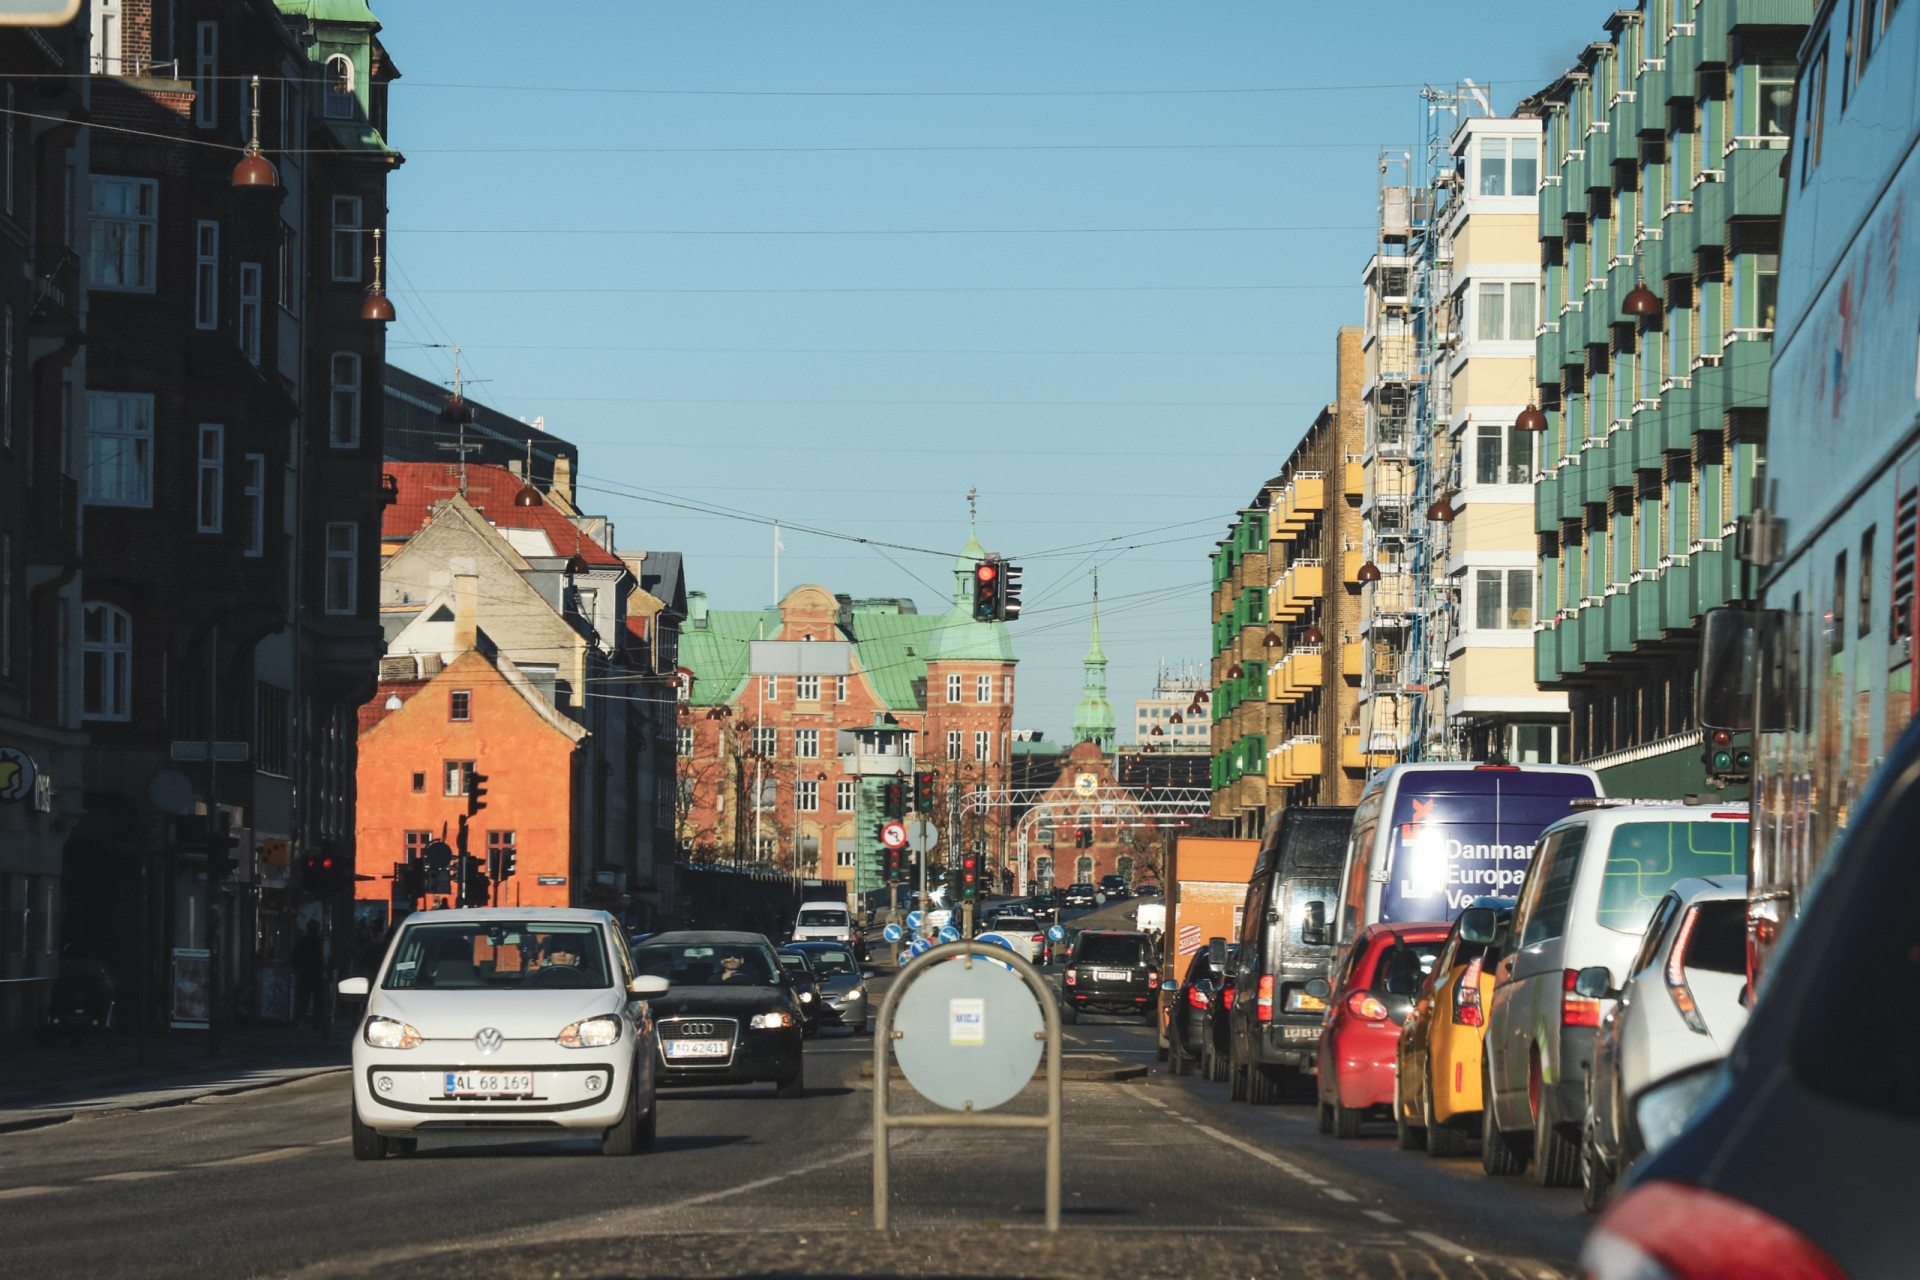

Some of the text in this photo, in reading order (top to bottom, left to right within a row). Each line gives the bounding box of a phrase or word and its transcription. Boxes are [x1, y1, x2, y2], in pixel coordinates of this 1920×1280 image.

[1446, 839, 1539, 860] Danmar
[1448, 864, 1525, 889] Europa
[692, 1043, 704, 1053] 42
[706, 1042, 725, 1053] 411
[456, 1075, 529, 1090] AL 68 169
